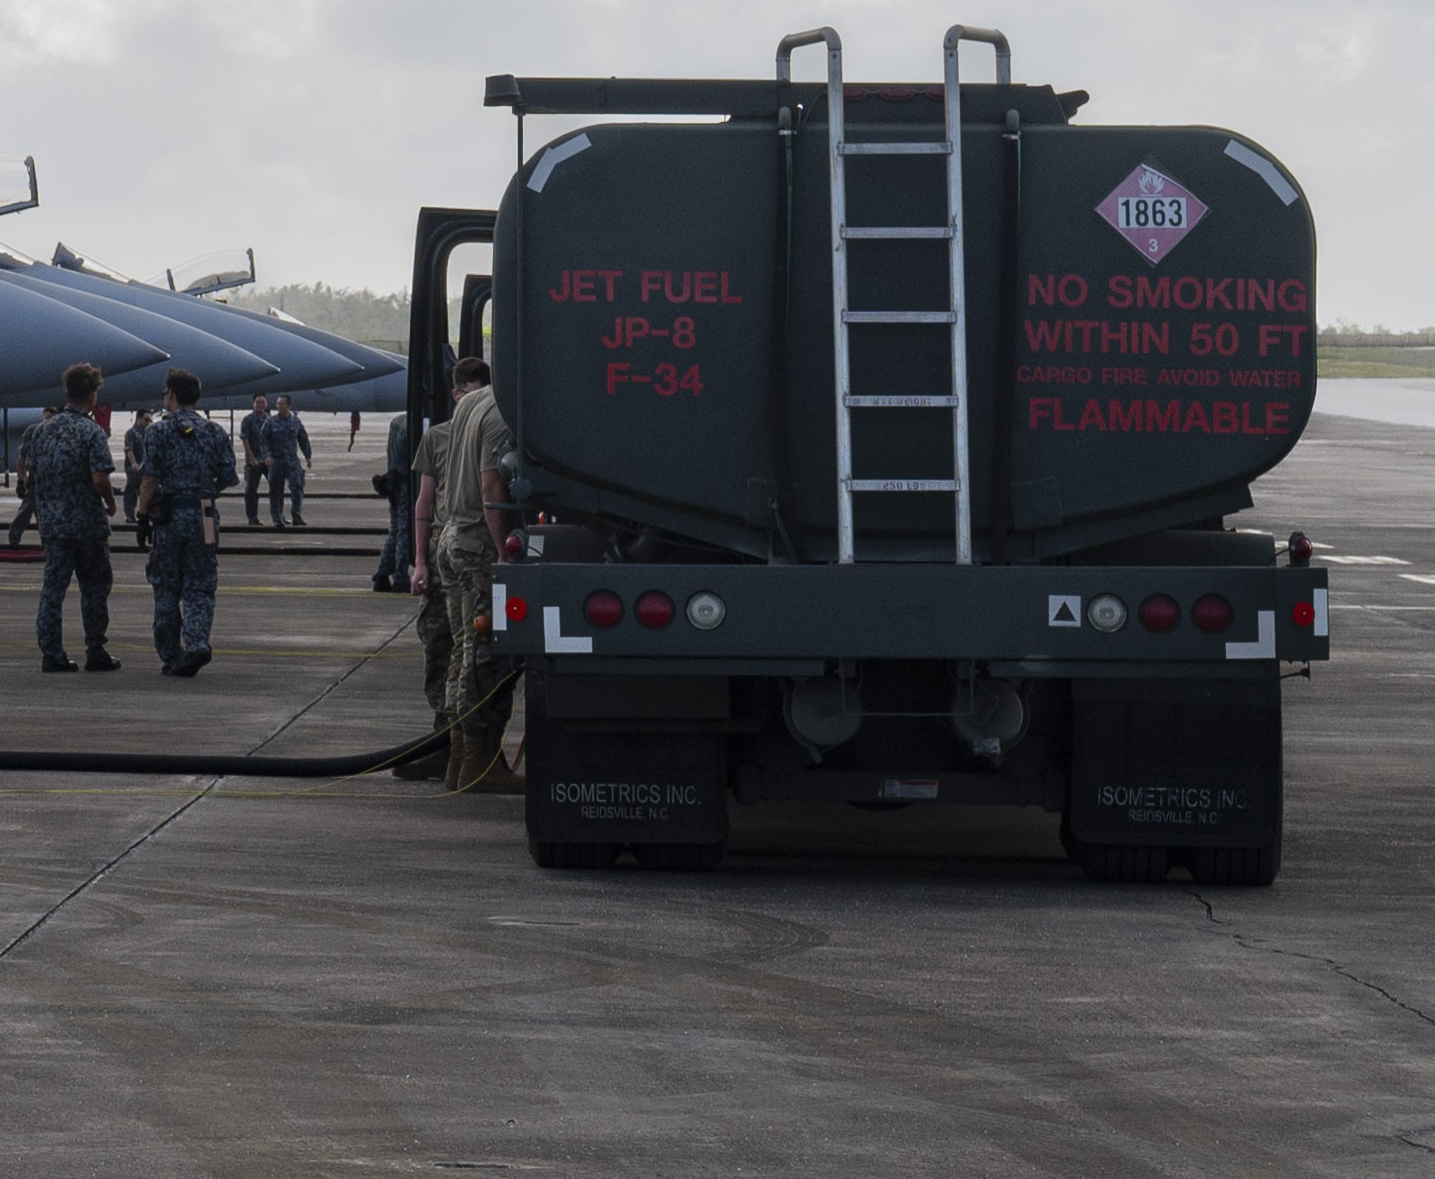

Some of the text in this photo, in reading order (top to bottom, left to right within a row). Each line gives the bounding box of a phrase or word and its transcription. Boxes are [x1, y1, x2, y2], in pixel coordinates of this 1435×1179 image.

[1121, 199, 1183, 227] 1863
[1148, 238, 1159, 253] 3
[549, 269, 744, 304] JET FUEL
[1027, 273, 1308, 313] NO SMOKING
[602, 315, 697, 350] JP-8
[1023, 320, 1309, 357] WITHIN 50 FT
[606, 362, 704, 397] F-34
[1016, 365, 1302, 388] CARGO FIRE AVOID WATER
[1028, 396, 1290, 435] FLAMMABLE
[550, 782, 702, 806] ISOMETRICS INC.
[1097, 786, 1212, 808] ISOMETRICS
